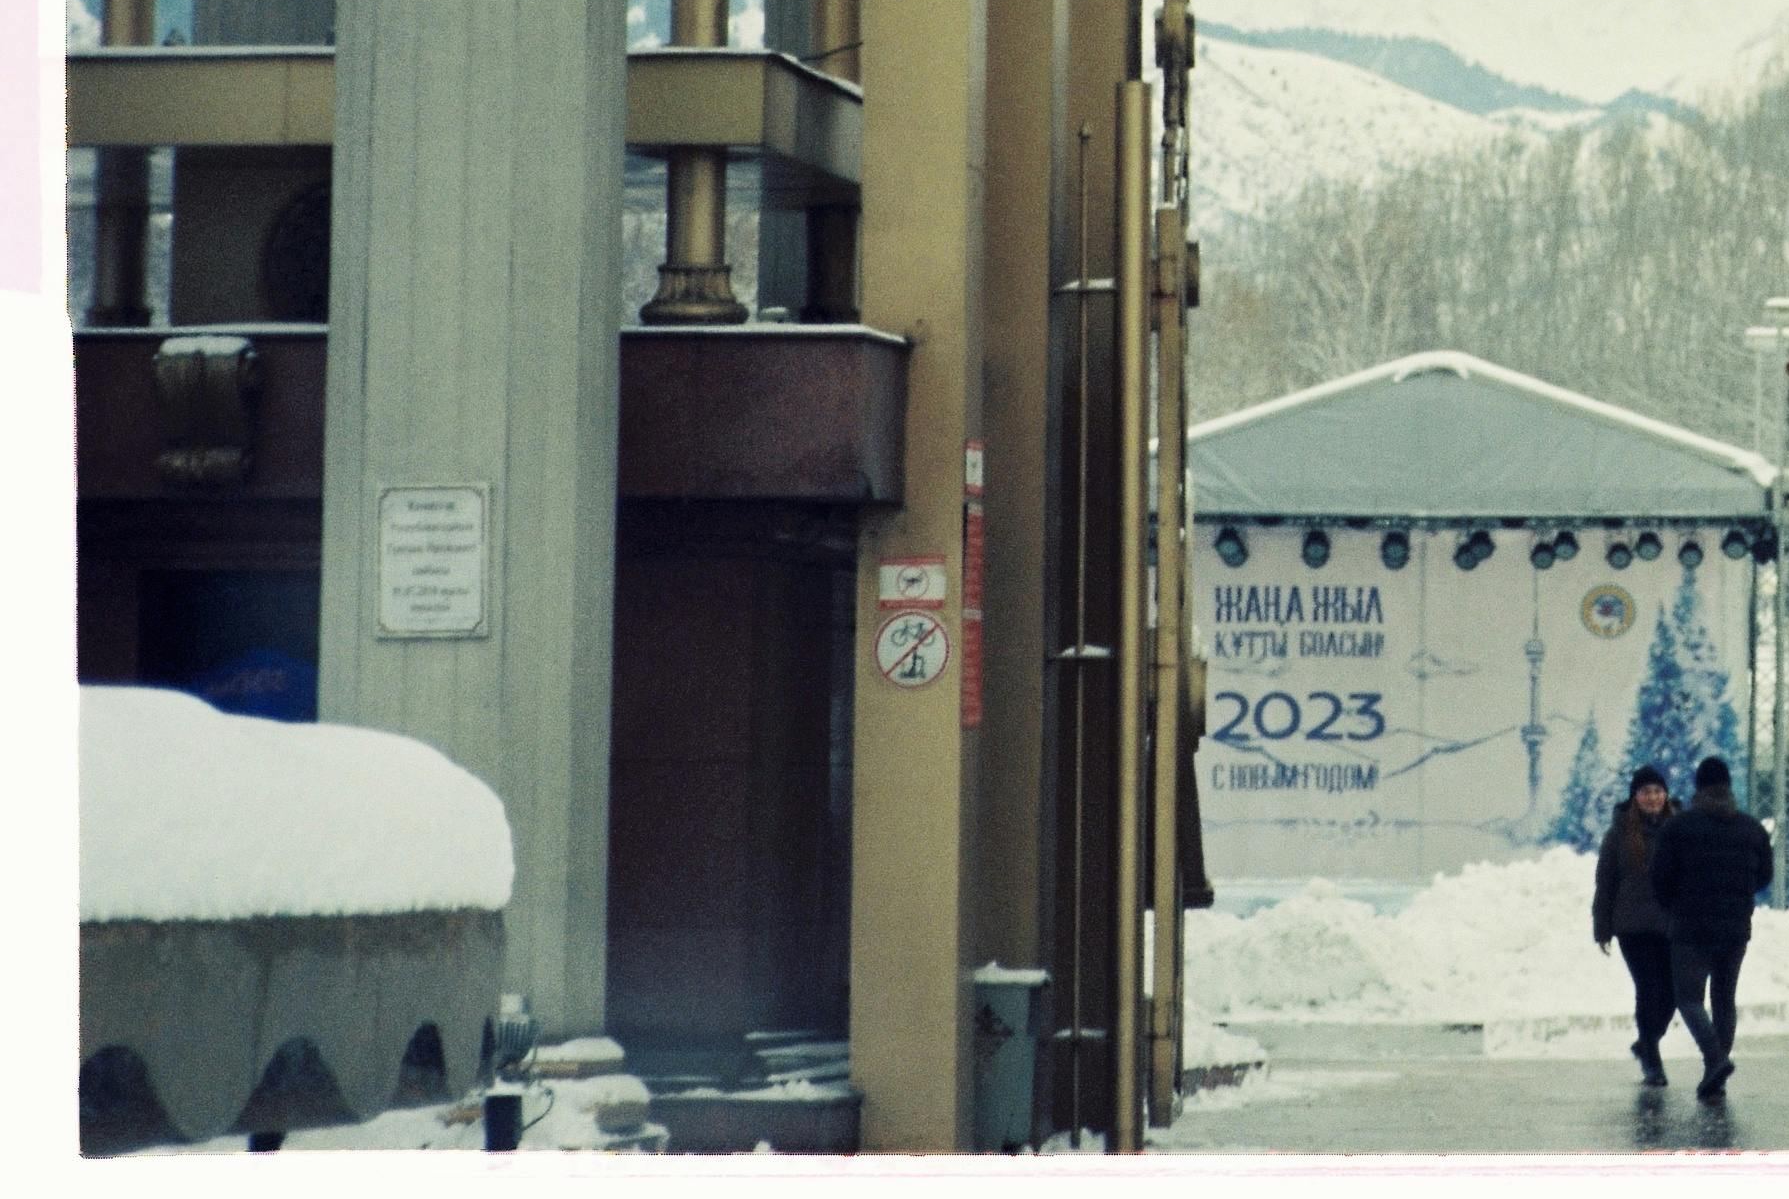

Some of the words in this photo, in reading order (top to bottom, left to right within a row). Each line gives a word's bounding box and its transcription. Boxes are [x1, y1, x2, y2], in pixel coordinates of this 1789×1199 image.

[1214, 586, 1304, 626] ЖАҢА
[1312, 586, 1383, 623] ЖЫЛ
[1212, 691, 1386, 741] 2023
